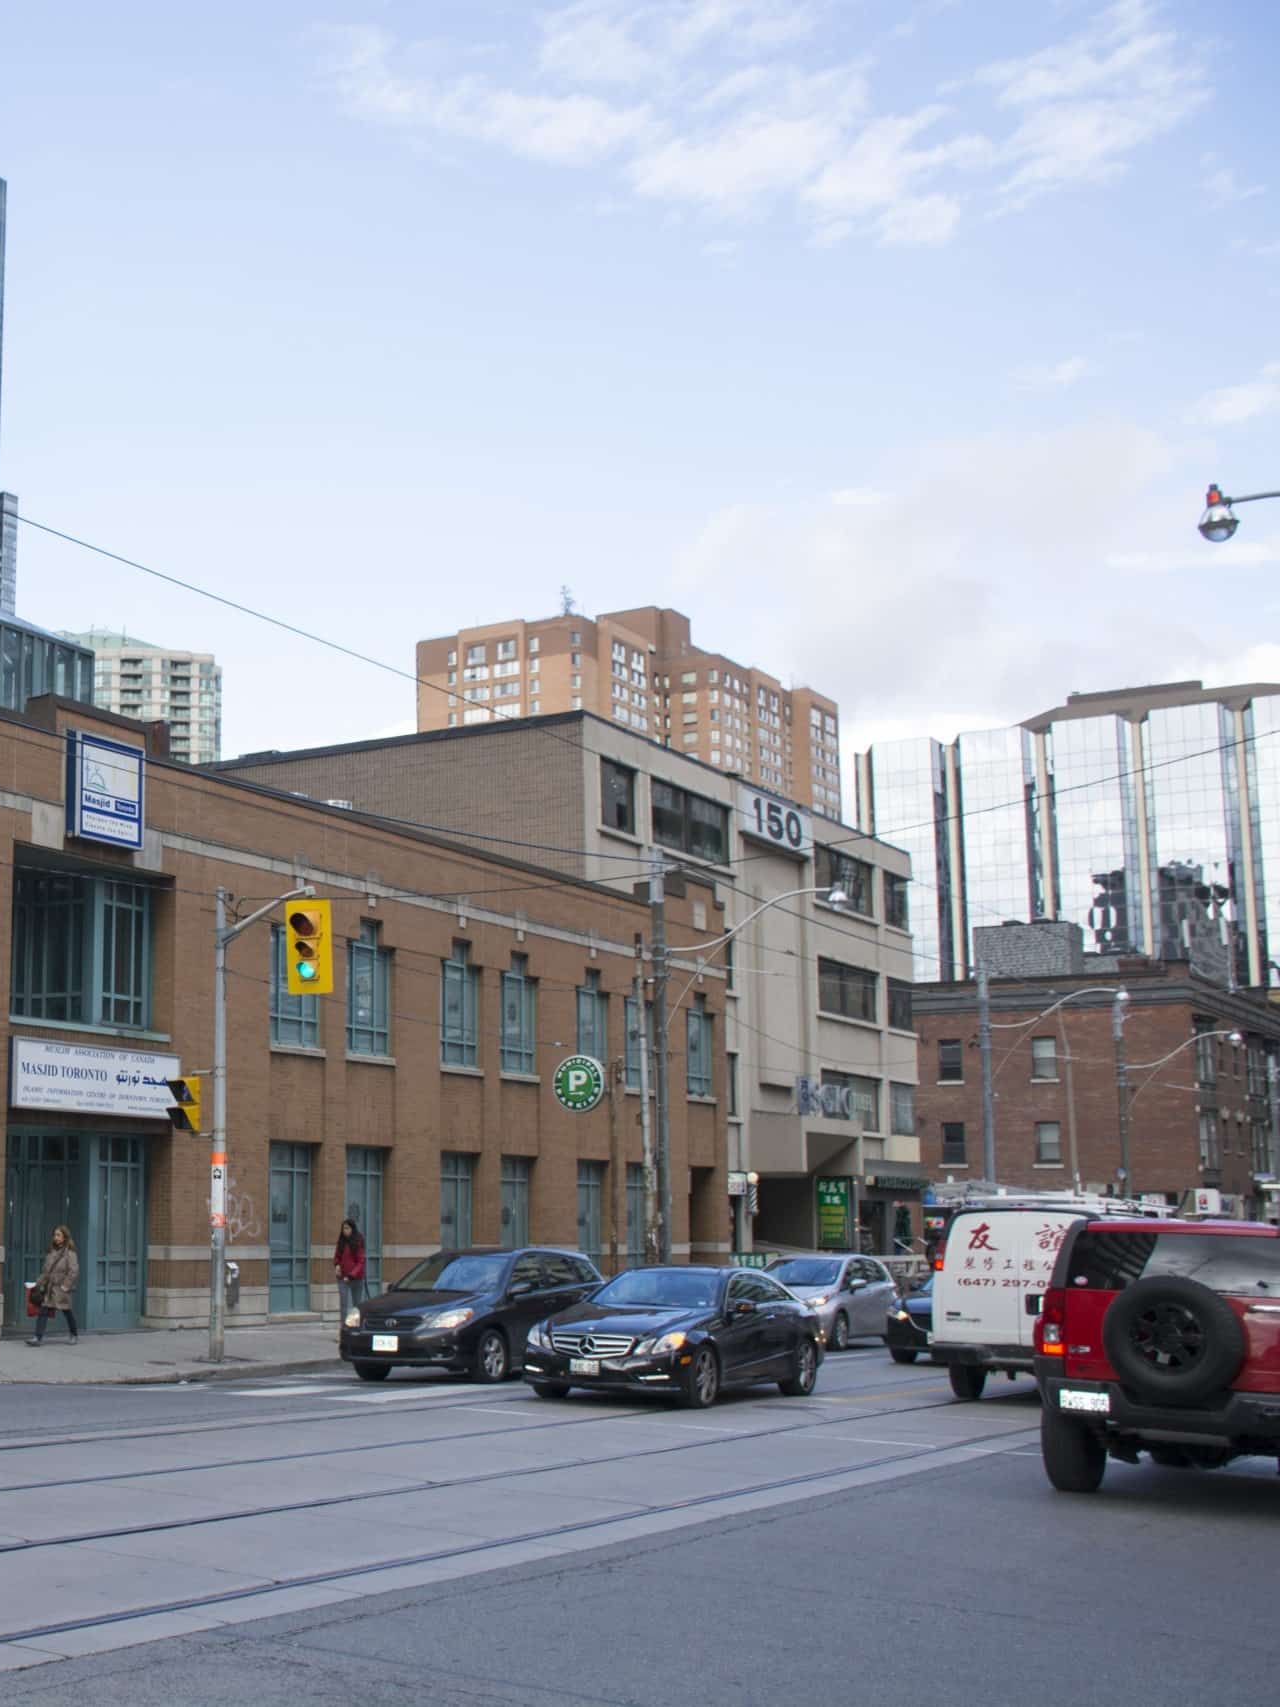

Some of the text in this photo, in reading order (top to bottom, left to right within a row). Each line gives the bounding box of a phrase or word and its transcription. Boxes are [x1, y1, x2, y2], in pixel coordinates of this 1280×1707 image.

[84, 793, 111, 808] Masjid
[753, 798, 802, 847] 150
[21, 1062, 108, 1082] MASJID TORONTO
[558, 1059, 598, 1079] MUNICIPAL
[115, 1070, 171, 1090] سجد تورنتو
[569, 1070, 587, 1091] P
[556, 1087, 600, 1108] PARKING
[957, 1278, 1051, 1289] (647) 297-0
